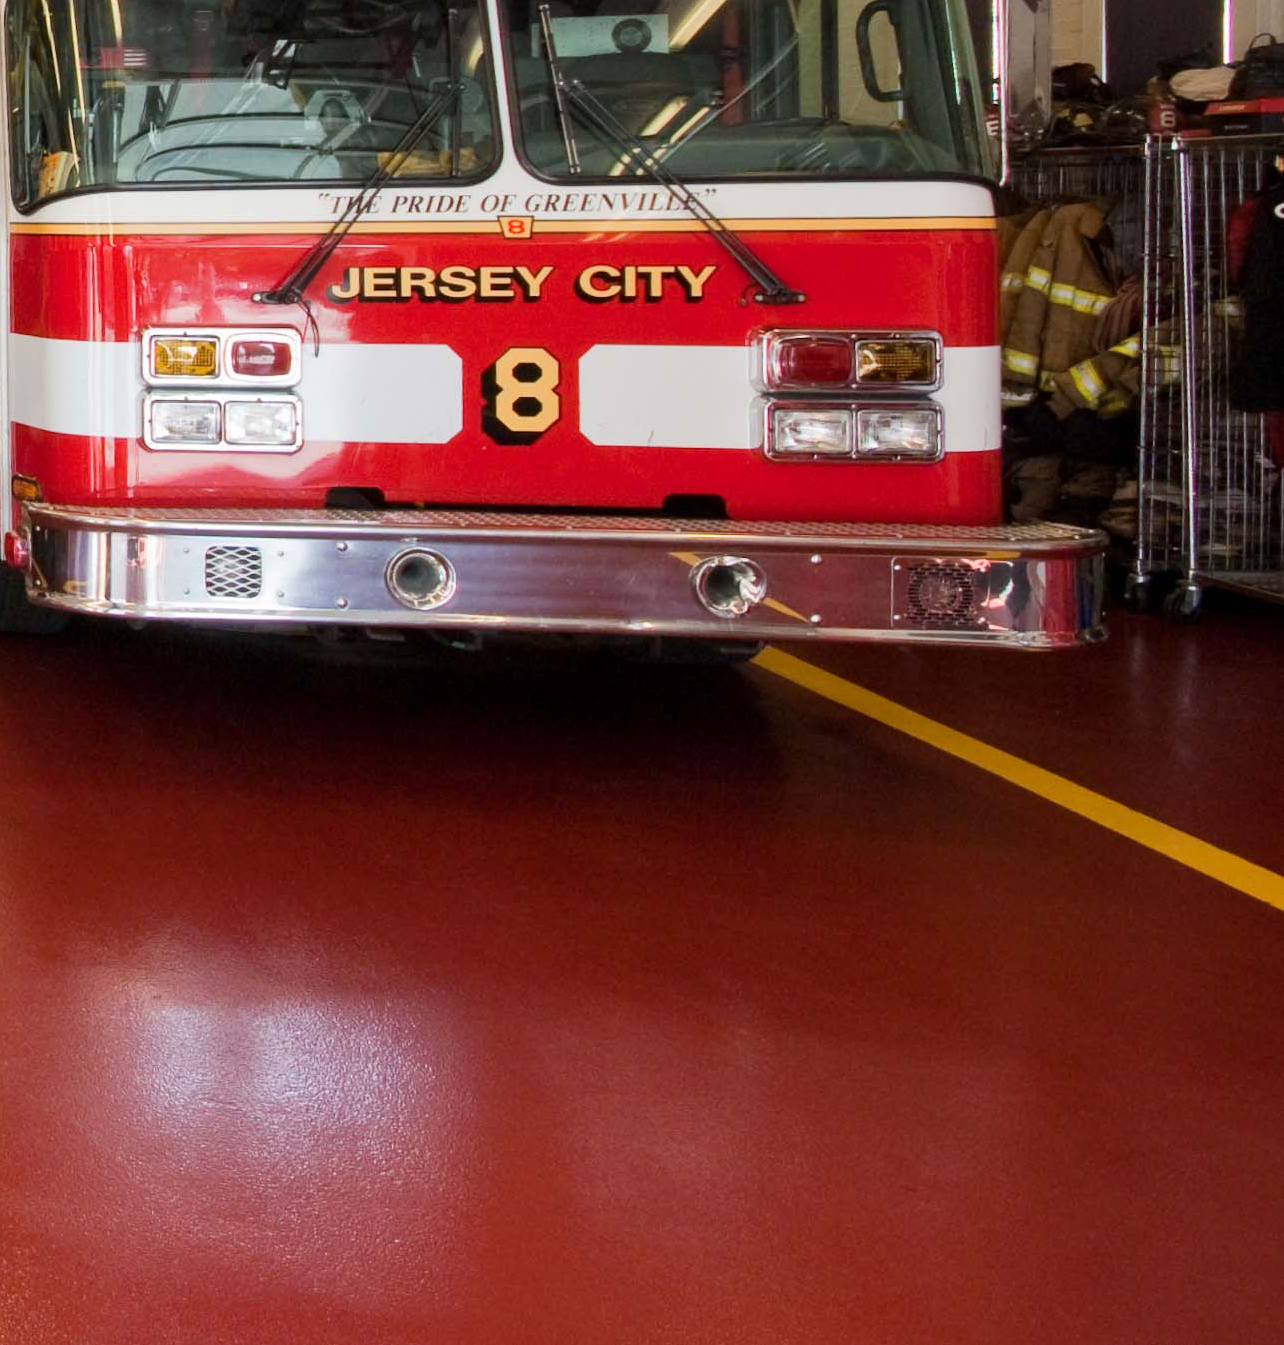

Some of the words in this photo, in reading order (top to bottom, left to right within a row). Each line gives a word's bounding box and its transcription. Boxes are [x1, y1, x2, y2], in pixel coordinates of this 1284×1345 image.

[391, 194, 471, 214] PRIDE
[481, 194, 516, 213] OF
[507, 219, 526, 234] 8
[328, 265, 555, 302] JERSEY
[576, 264, 717, 302] CITY
[483, 347, 560, 443] 8
